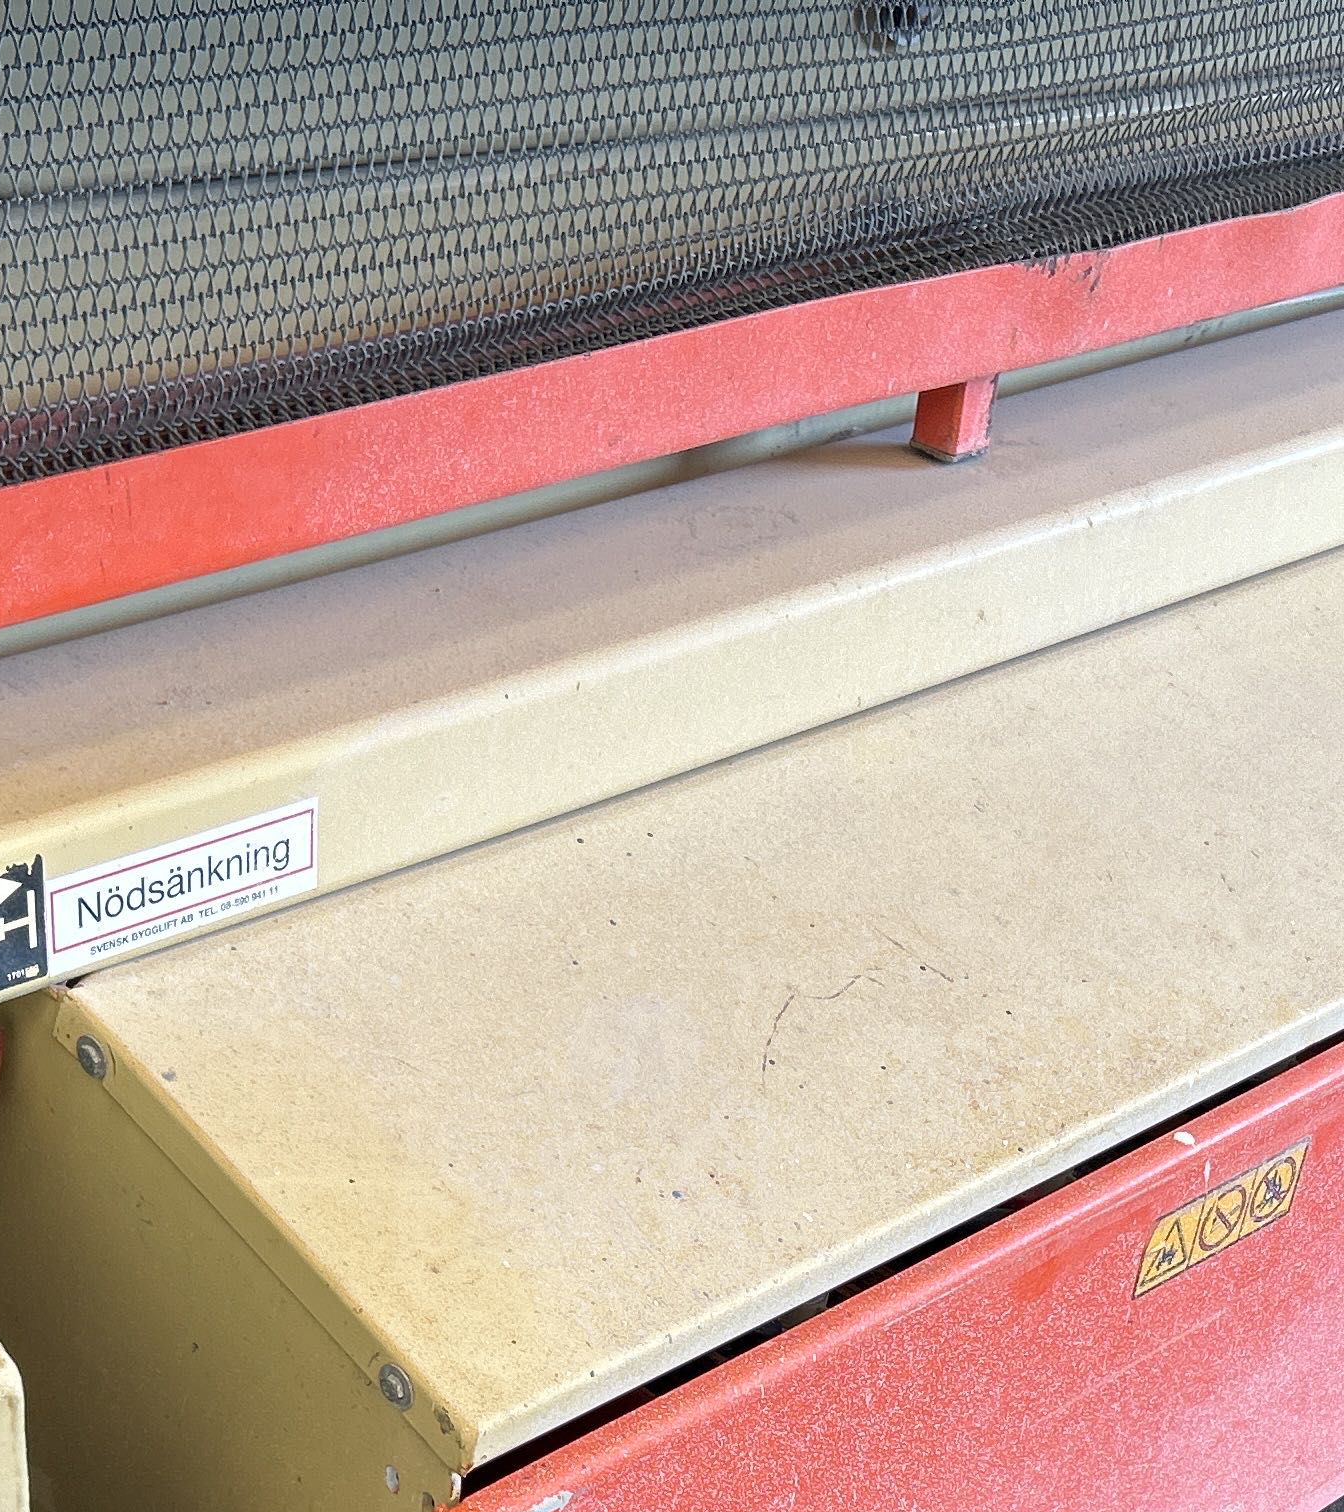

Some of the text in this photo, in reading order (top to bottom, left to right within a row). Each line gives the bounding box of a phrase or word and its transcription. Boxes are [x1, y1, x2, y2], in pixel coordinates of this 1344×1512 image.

[77, 838, 290, 928] Nödsänkning
[90, 935, 129, 955] SVENSK
[131, 918, 178, 942] BYGGLIFT
[180, 913, 194, 925] AB
